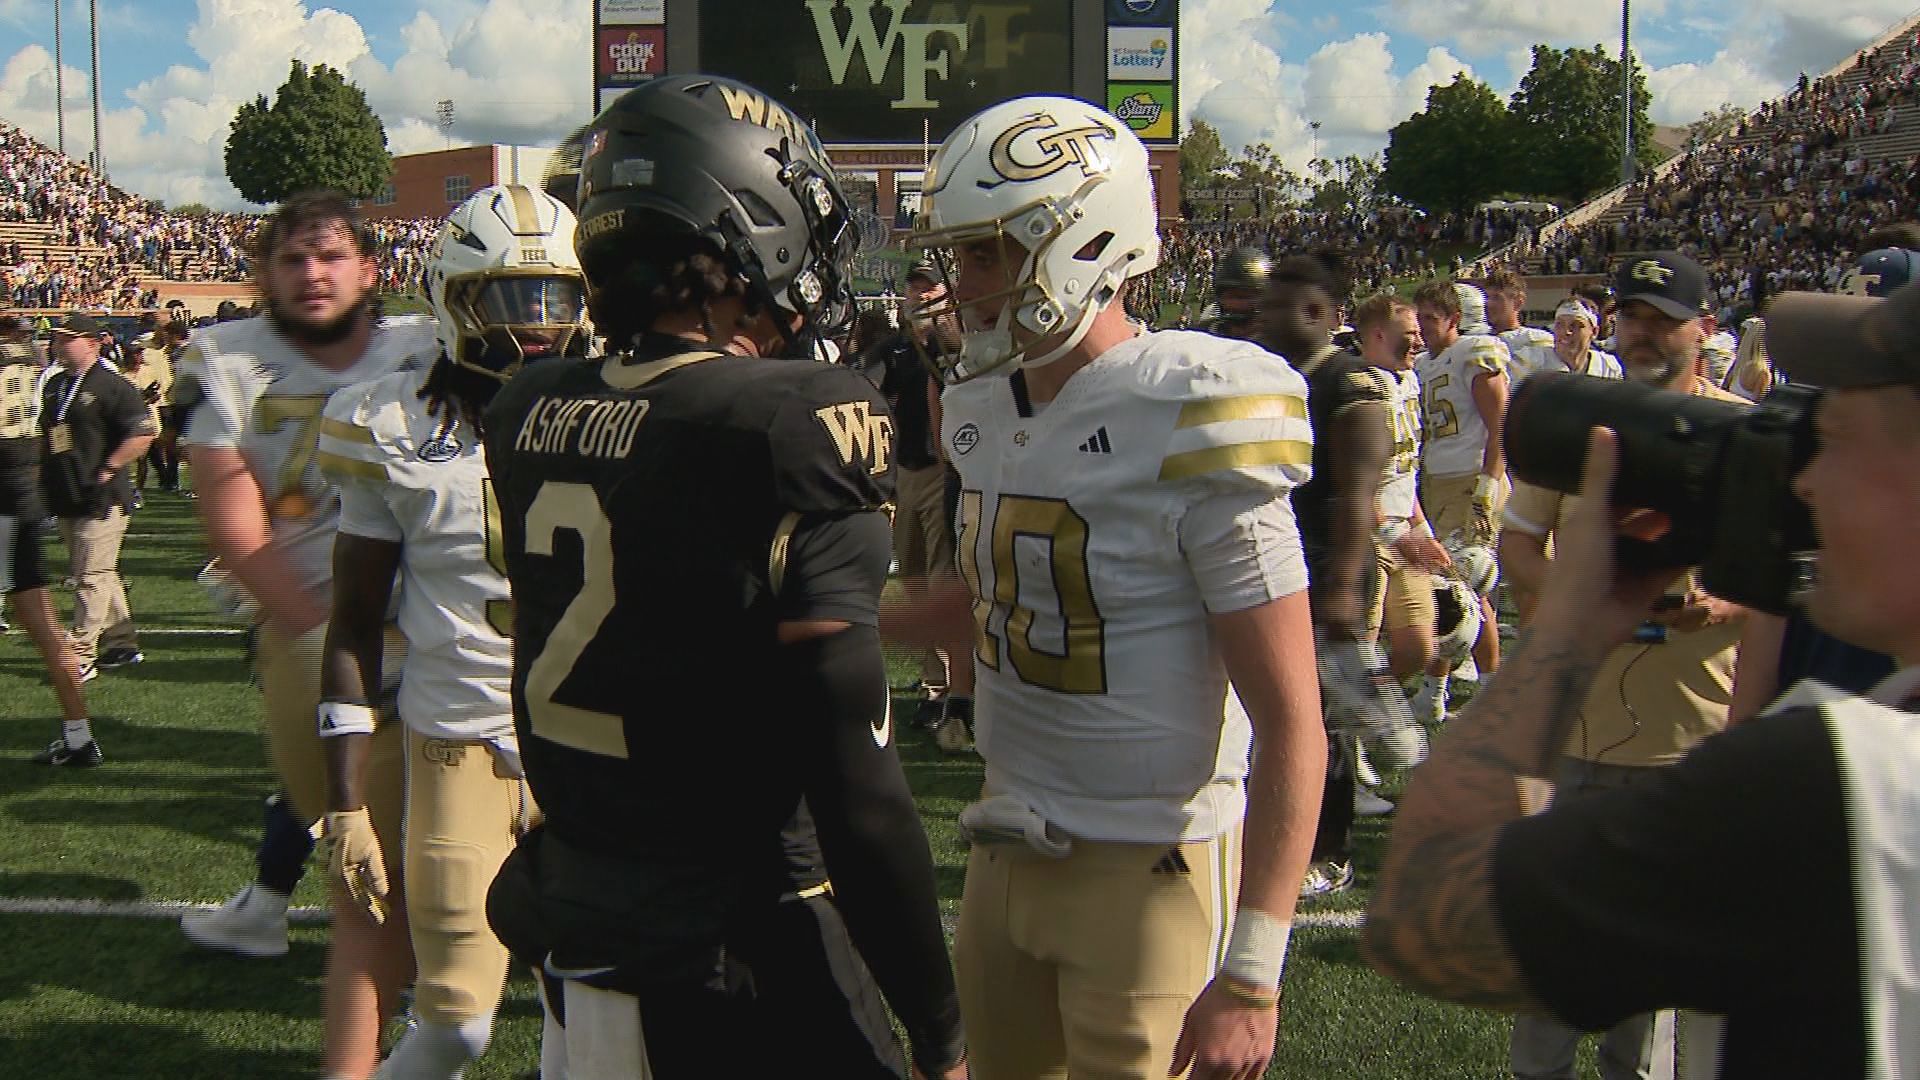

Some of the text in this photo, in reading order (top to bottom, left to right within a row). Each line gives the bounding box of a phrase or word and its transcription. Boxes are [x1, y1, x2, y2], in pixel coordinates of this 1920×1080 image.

[608, 43, 655, 58] COOK
[615, 58, 648, 73] OUT
[804, 0, 967, 108] WF
[1113, 54, 1165, 68] Lottery
[1117, 97, 1161, 122] Starry
[989, 114, 1116, 182] GT
[583, 208, 625, 240] FOREST
[252, 394, 324, 492] 7
[515, 396, 650, 459] ASHFORD
[813, 401, 895, 475] WF
[524, 479, 629, 759] 2
[959, 489, 1108, 695] 10
